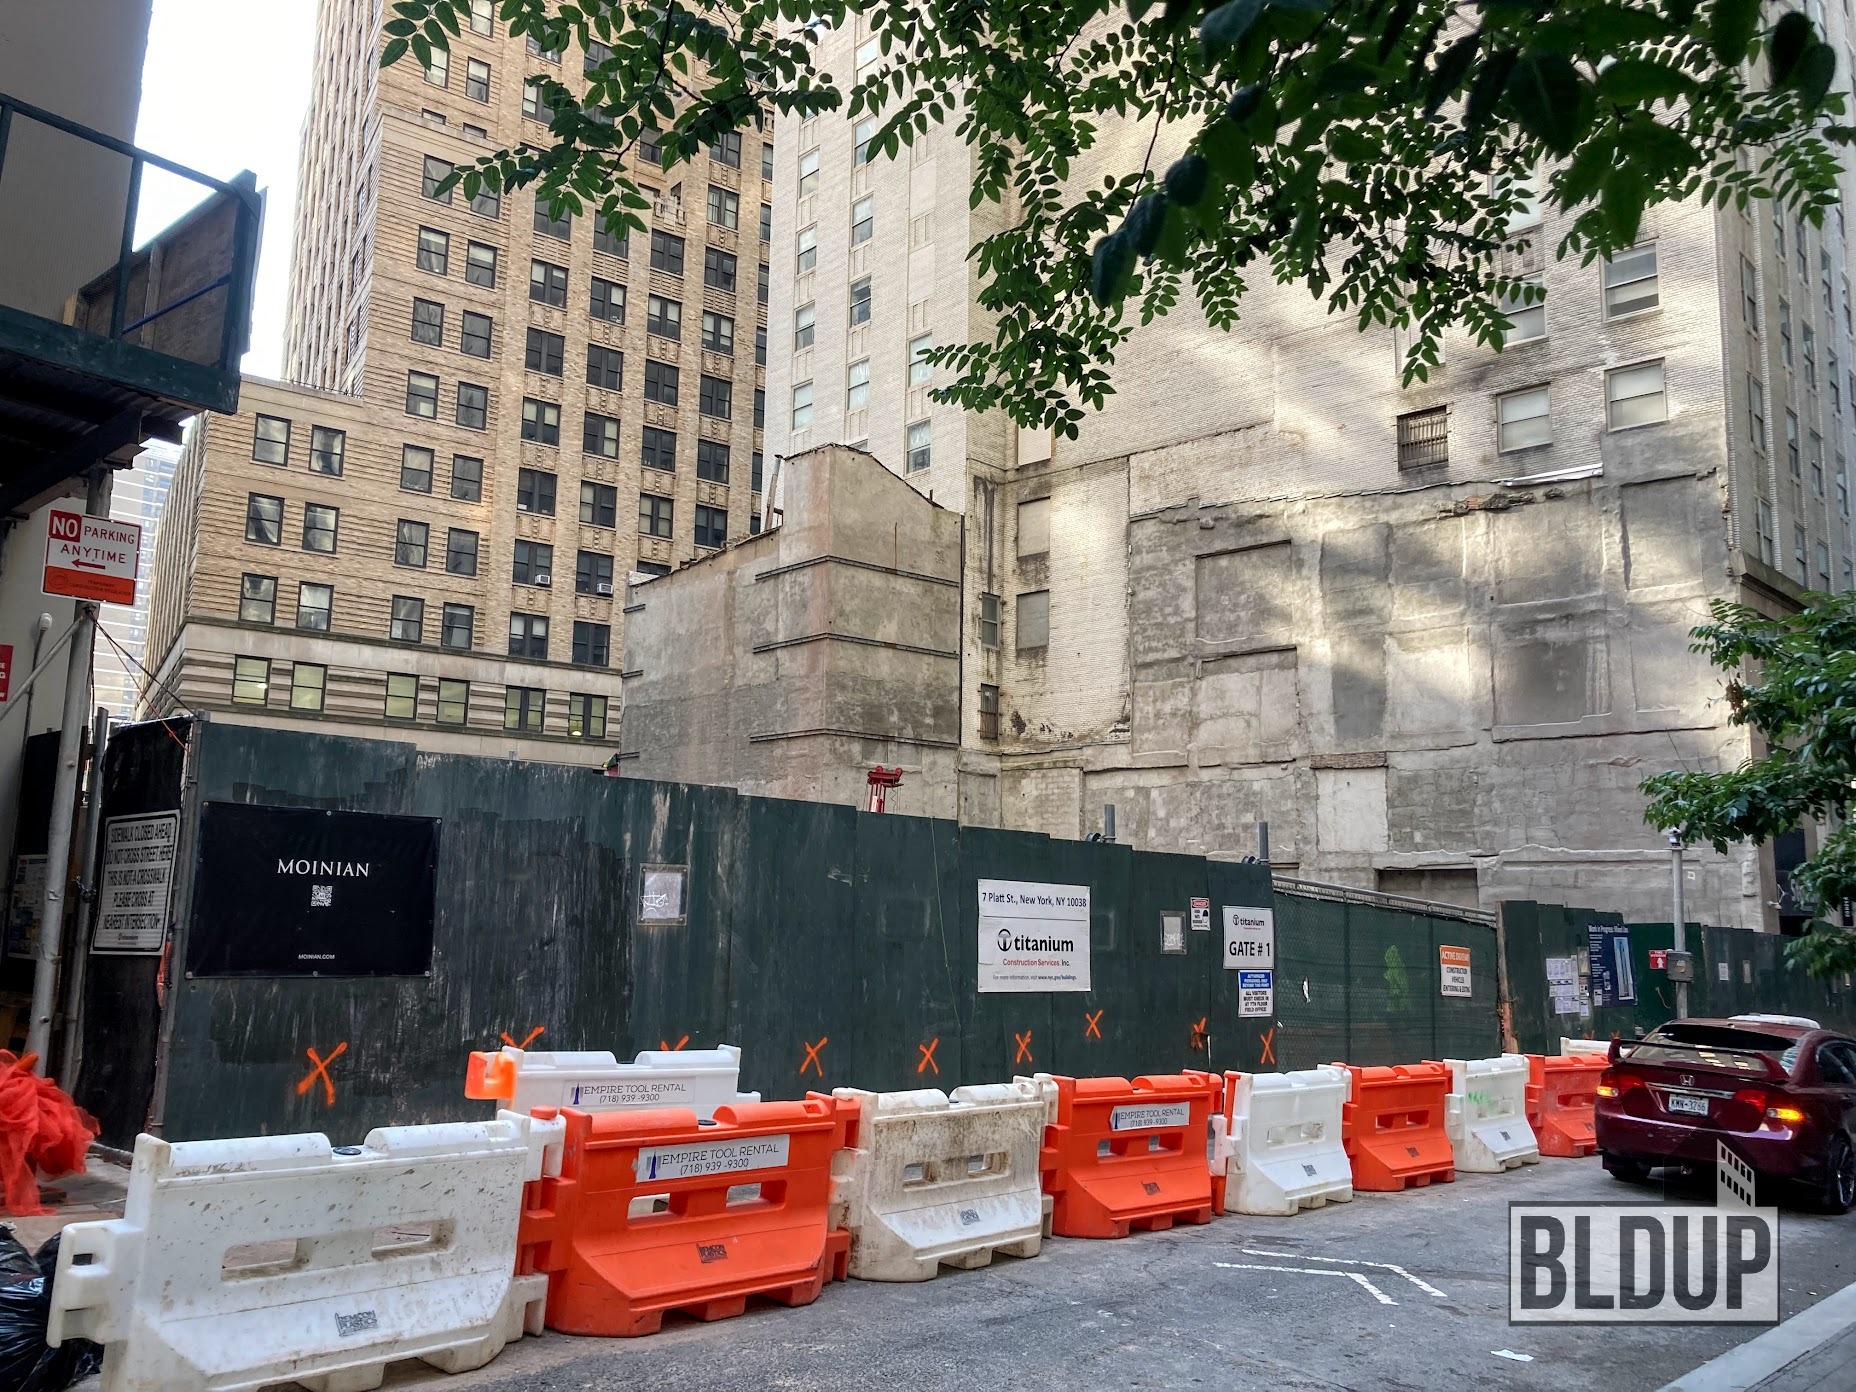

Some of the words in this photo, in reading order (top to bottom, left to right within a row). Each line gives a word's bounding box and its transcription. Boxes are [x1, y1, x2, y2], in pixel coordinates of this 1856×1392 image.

[51, 516, 78, 538] NO
[84, 525, 135, 545] PARKING
[60, 543, 126, 564] ANYTIME
[111, 826, 134, 843] SIDEWALK
[135, 824, 154, 841] CLOSED
[154, 822, 172, 840] AHEAD
[124, 847, 140, 864] CROSS
[140, 846, 159, 863] STREET
[160, 844, 173, 861] HERE
[277, 858, 369, 877] MOINIAN
[108, 870, 118, 887] THIS
[137, 867, 166, 885] CROSSWALK
[113, 891, 132, 908] PLEASE
[132, 890, 147, 907] CROSS
[147, 890, 155, 907] AT
[982, 892, 987, 901] 7
[988, 892, 1005, 903] Platt
[1020, 894, 1036, 905] New
[1037, 895, 1055, 907] York,
[1055, 896, 1066, 906] NY
[1067, 897, 1087, 907] 10038
[103, 913, 125, 930] NEAREST
[1240, 917, 1265, 926] titanium
[1014, 934, 1074, 952] titanium
[1229, 941, 1255, 956] GATE
[1257, 942, 1263, 956] #
[1266, 942, 1270, 957] 1
[1002, 958, 1037, 967] Construction
[584, 1085, 624, 1095] EMPIRE
[626, 1084, 650, 1093] TOOL
[651, 1083, 687, 1092] RENTAL
[599, 1095, 619, 1104] (718)
[621, 1094, 636, 1102] 939
[1120, 1110, 1145, 1120] EMPIRE
[1146, 1109, 1161, 1118] TOOL
[1161, 1108, 1184, 1117] RENTAL
[1130, 1119, 1143, 1128] (718)
[1143, 1118, 1153, 1127] 939
[662, 1150, 708, 1165] EMPIRE
[710, 1147, 737, 1160] TOOL
[739, 1143, 779, 1156] RENTAL
[680, 1164, 703, 1176] (718)
[705, 1161, 722, 1172] 939
